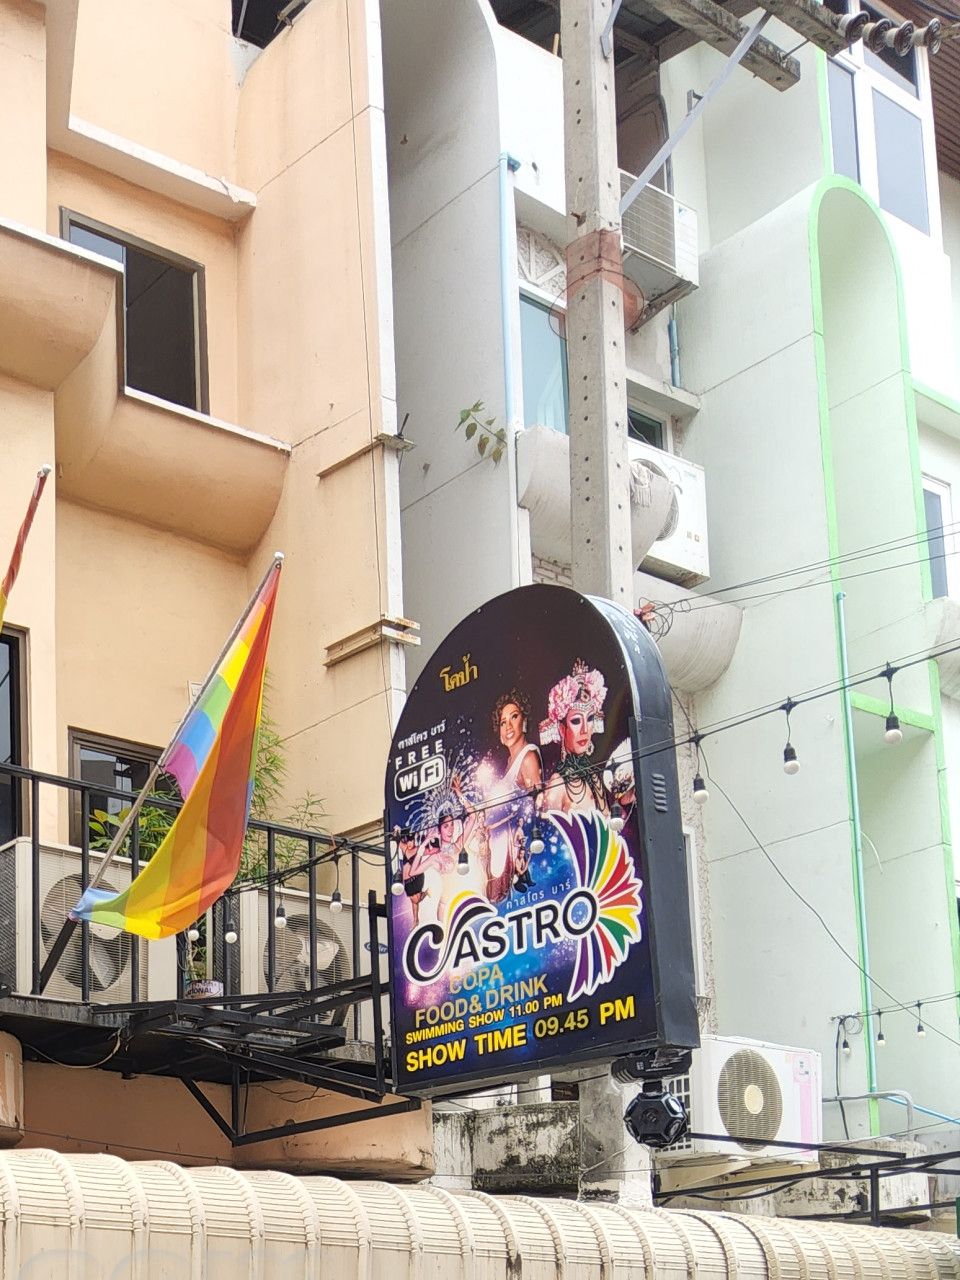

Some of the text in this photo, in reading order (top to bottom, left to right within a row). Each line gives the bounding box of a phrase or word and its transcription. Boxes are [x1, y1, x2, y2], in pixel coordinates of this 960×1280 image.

[395, 739, 444, 771] FREE
[551, 878, 571, 895] บาร์
[404, 888, 599, 982] CASTRO
[449, 964, 504, 995] COPA
[405, 993, 563, 1045] SWIMMING SHOW 11.00 PM
[405, 996, 636, 1072] SHOW TIME 09.45 PM
